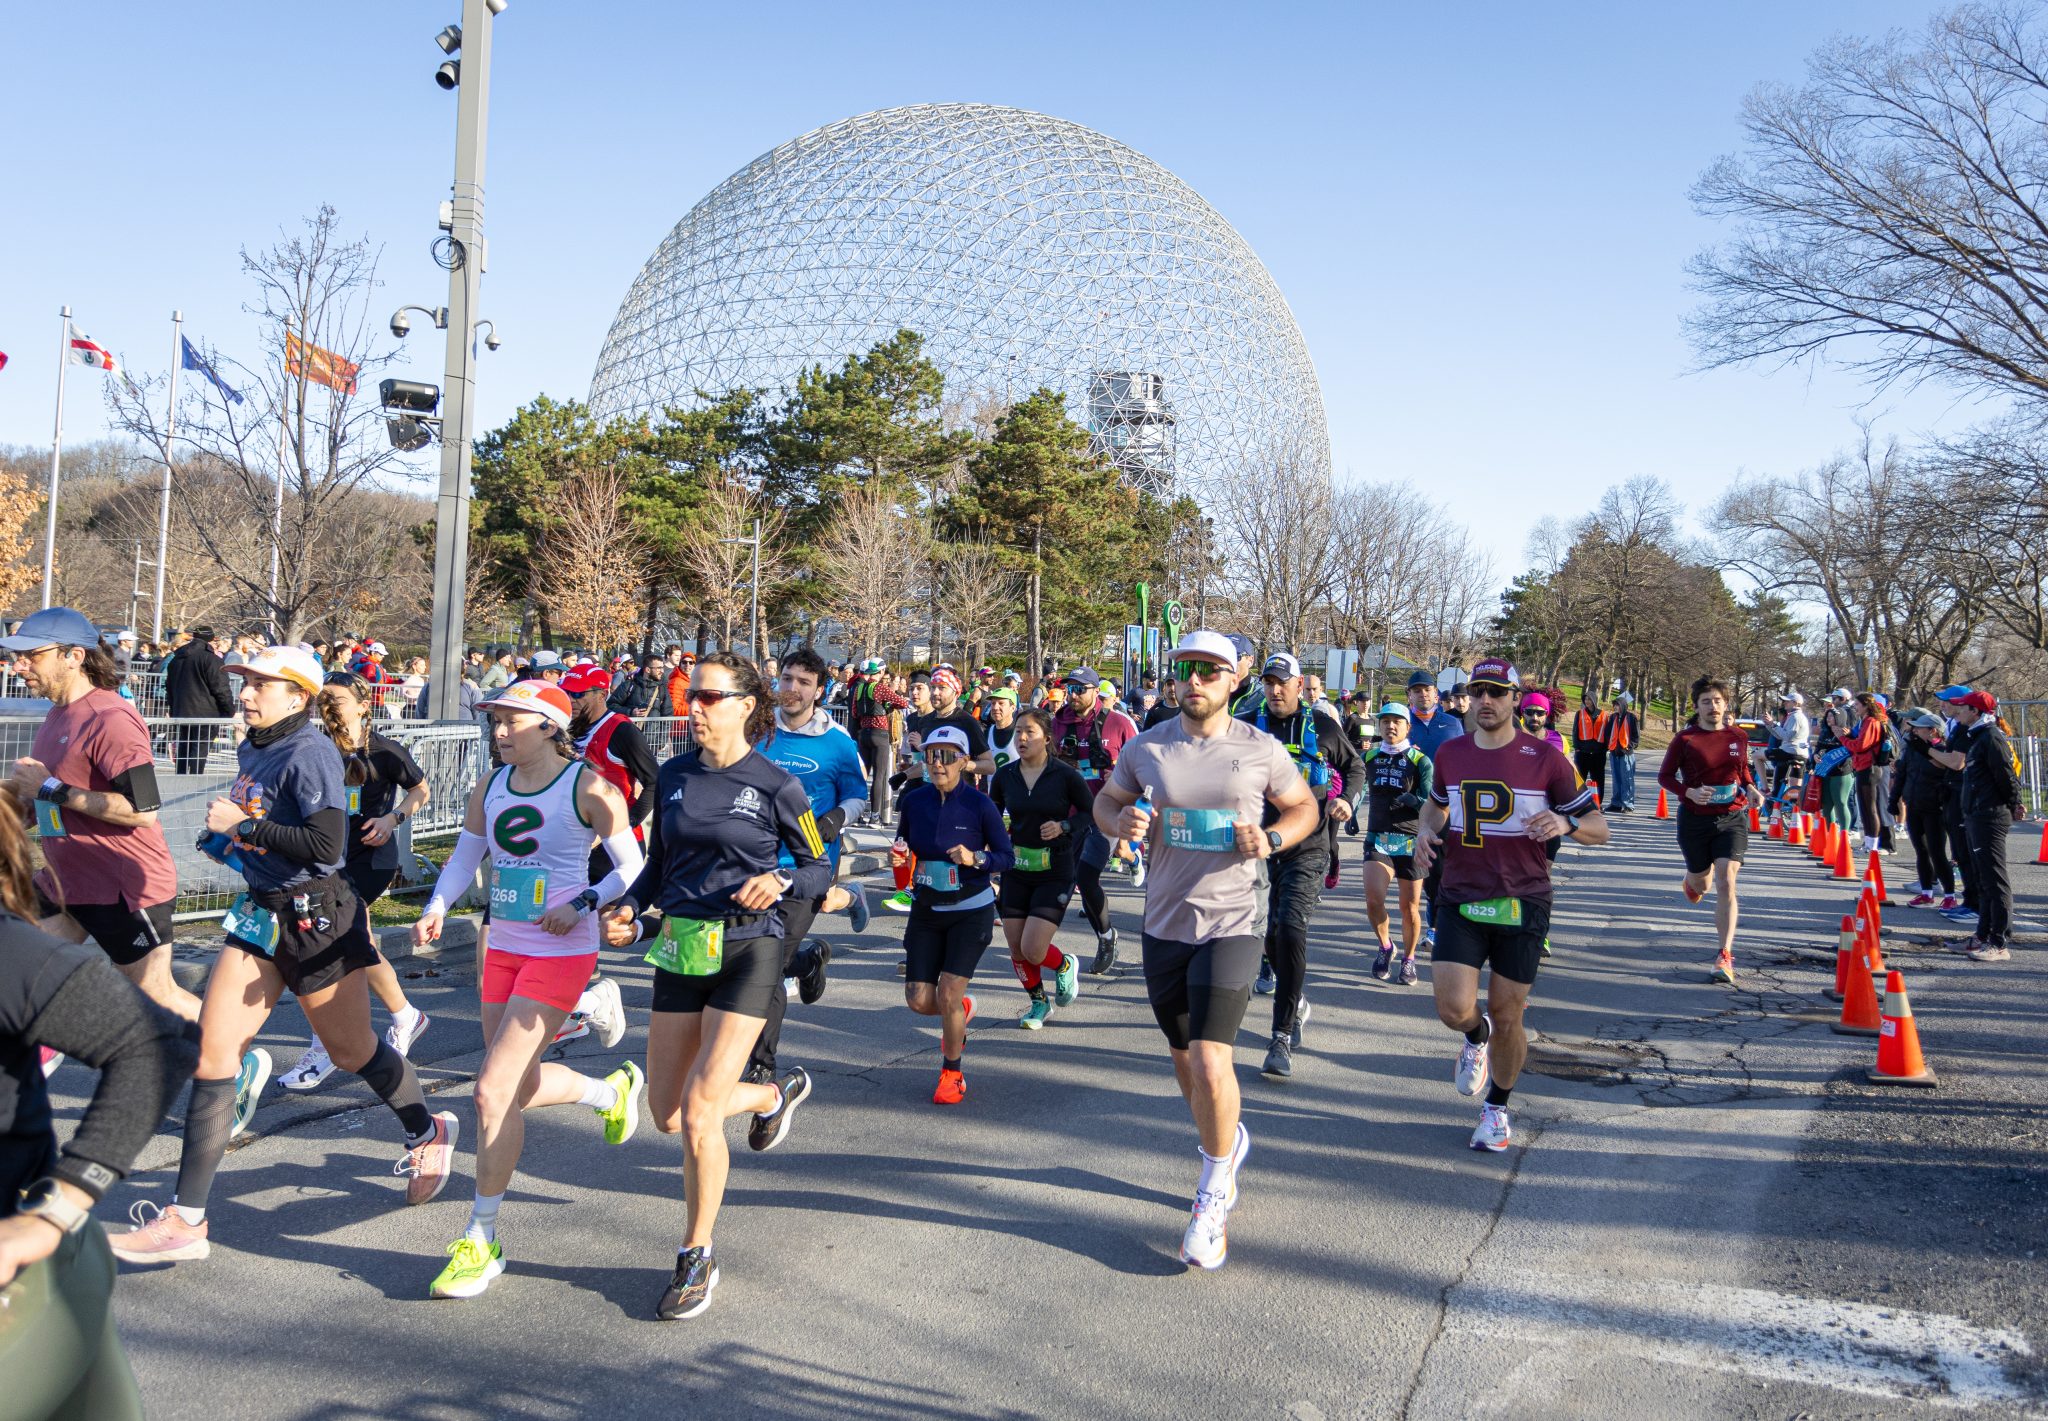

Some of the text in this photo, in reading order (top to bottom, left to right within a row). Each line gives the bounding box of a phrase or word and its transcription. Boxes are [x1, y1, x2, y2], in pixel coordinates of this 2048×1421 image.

[774, 758, 791, 767] Sport
[791, 761, 812, 769] Physio
[1460, 779, 1514, 849] P
[493, 803, 545, 859] e
[1170, 828, 1192, 842] 911
[491, 887, 518, 904] 2268
[1466, 904, 1496, 917] 1629
